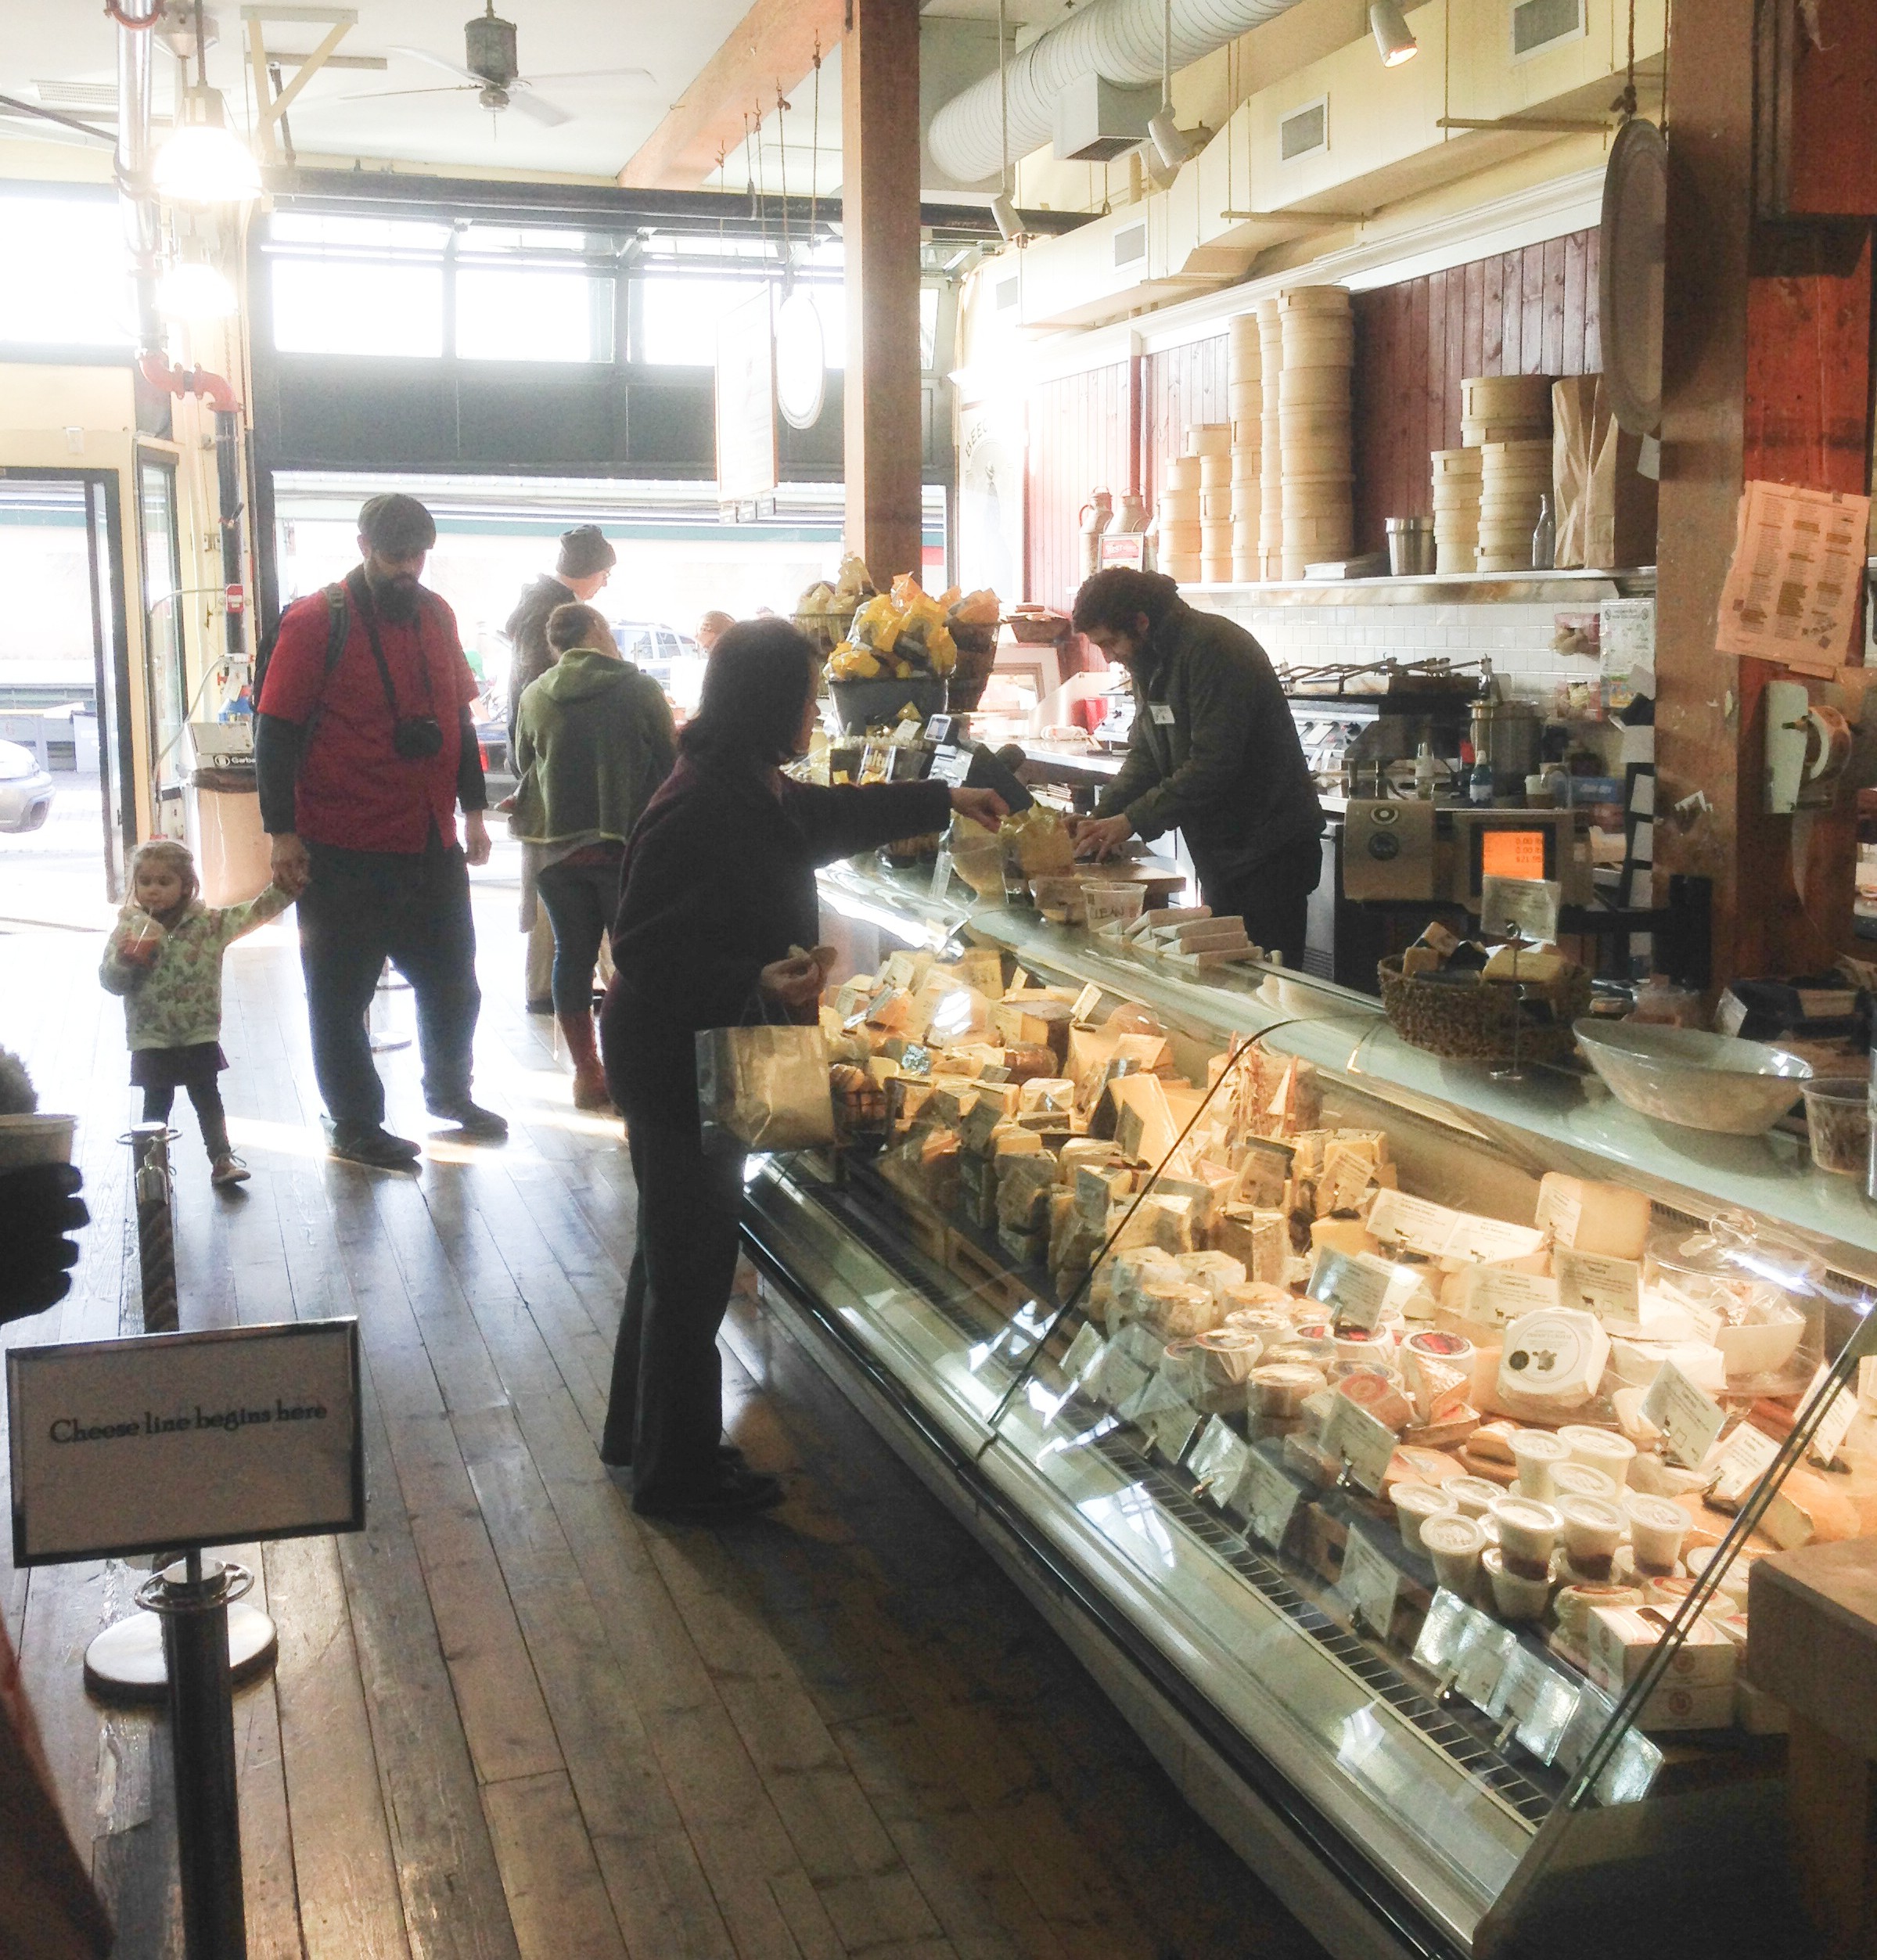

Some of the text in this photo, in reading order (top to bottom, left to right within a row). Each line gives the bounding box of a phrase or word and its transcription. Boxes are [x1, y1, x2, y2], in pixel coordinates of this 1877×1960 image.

[965, 418, 991, 458] BEEC
[49, 1399, 328, 1444] Cheese line begins here
